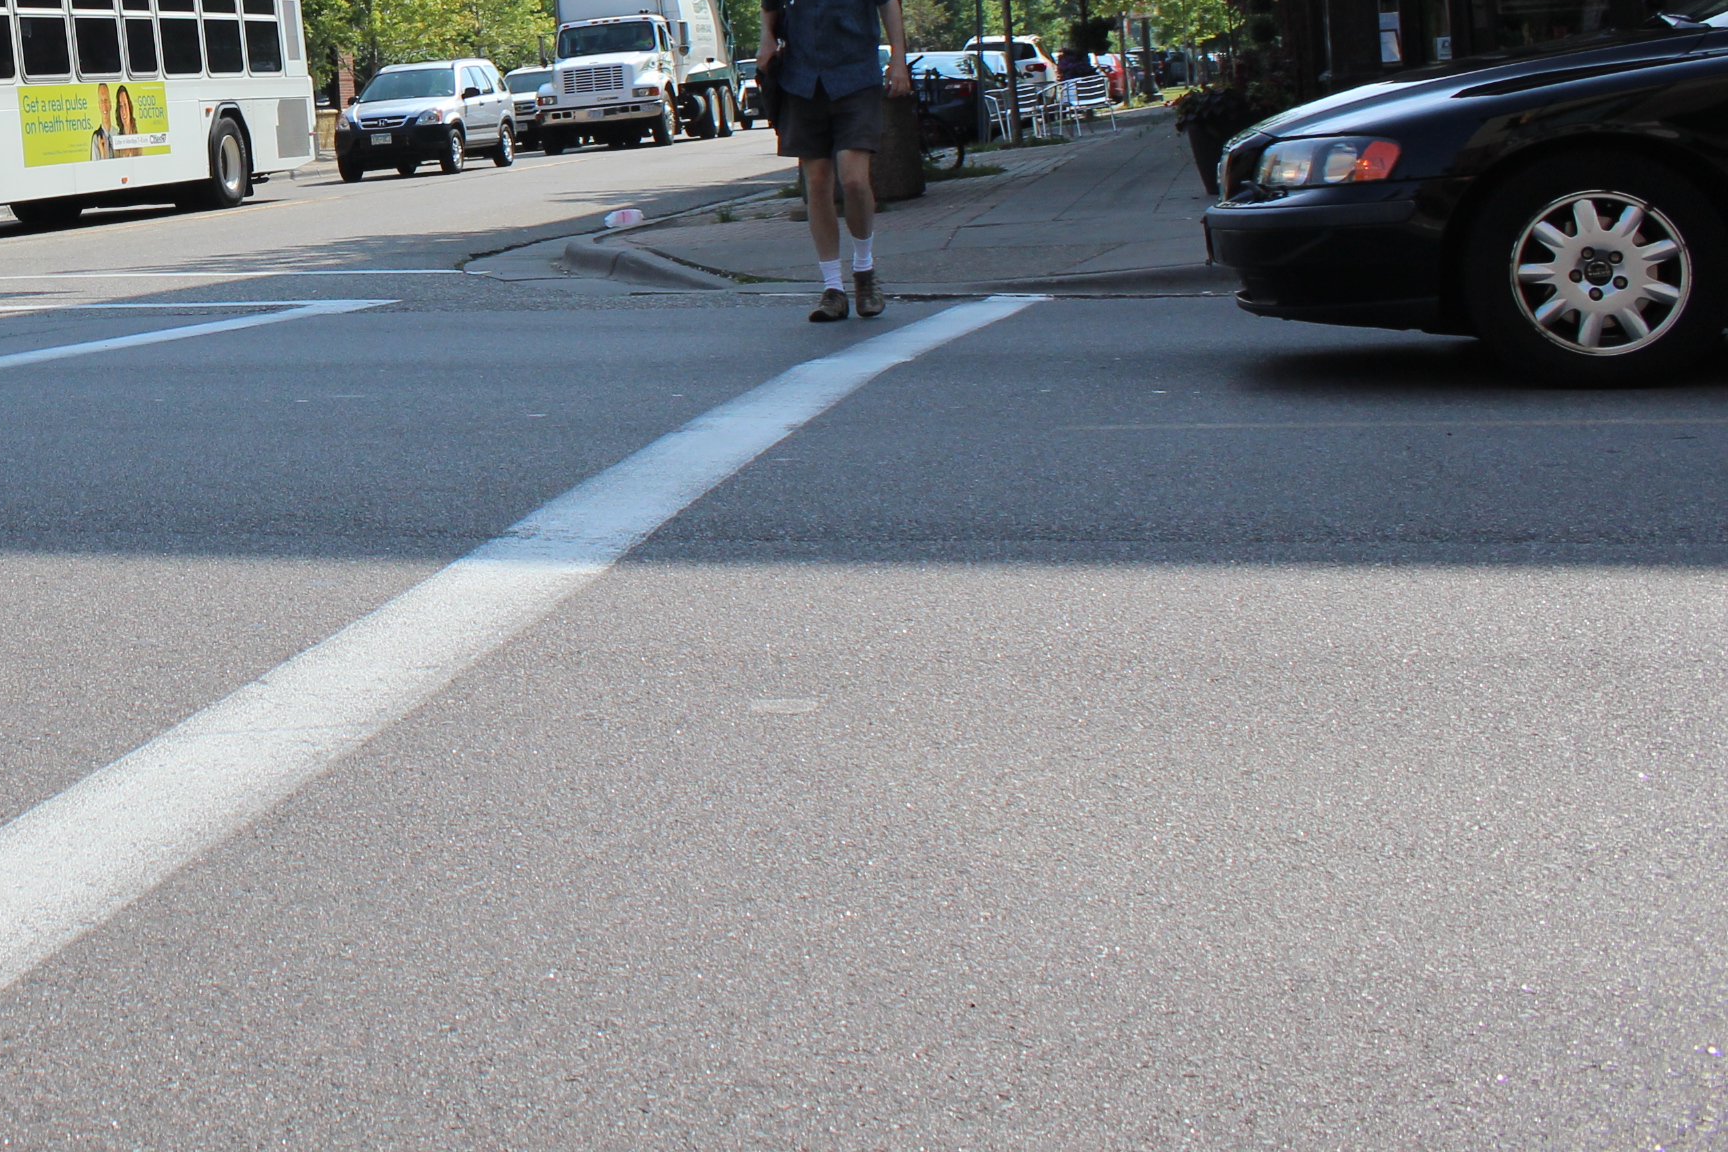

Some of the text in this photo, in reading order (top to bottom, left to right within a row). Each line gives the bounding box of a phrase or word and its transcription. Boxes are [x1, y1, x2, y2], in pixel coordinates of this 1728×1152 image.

[23, 93, 88, 115] Get a real pulse
[137, 95, 156, 106] GOOD
[139, 107, 164, 119] DOCTOR
[25, 121, 37, 134] on
[38, 115, 64, 133] health
